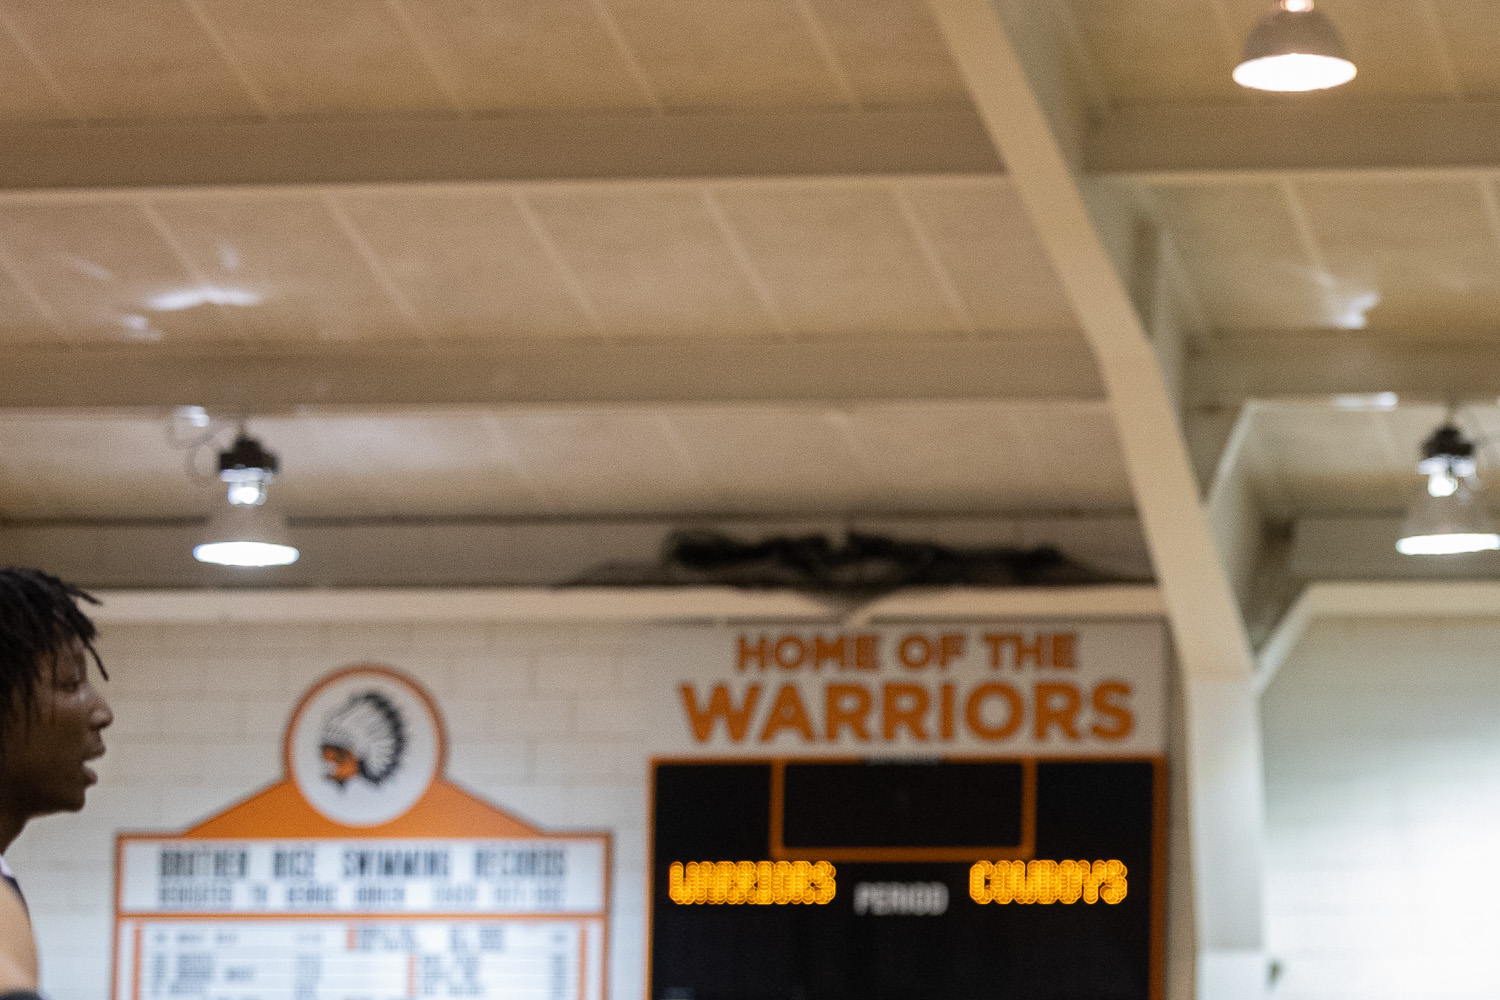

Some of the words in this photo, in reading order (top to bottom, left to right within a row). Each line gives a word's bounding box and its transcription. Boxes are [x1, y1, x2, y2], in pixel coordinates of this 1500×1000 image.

[736, 632, 880, 671] HOME
[899, 632, 966, 671] OF
[983, 631, 1078, 670] THE
[679, 681, 1136, 742] WARRIORS
